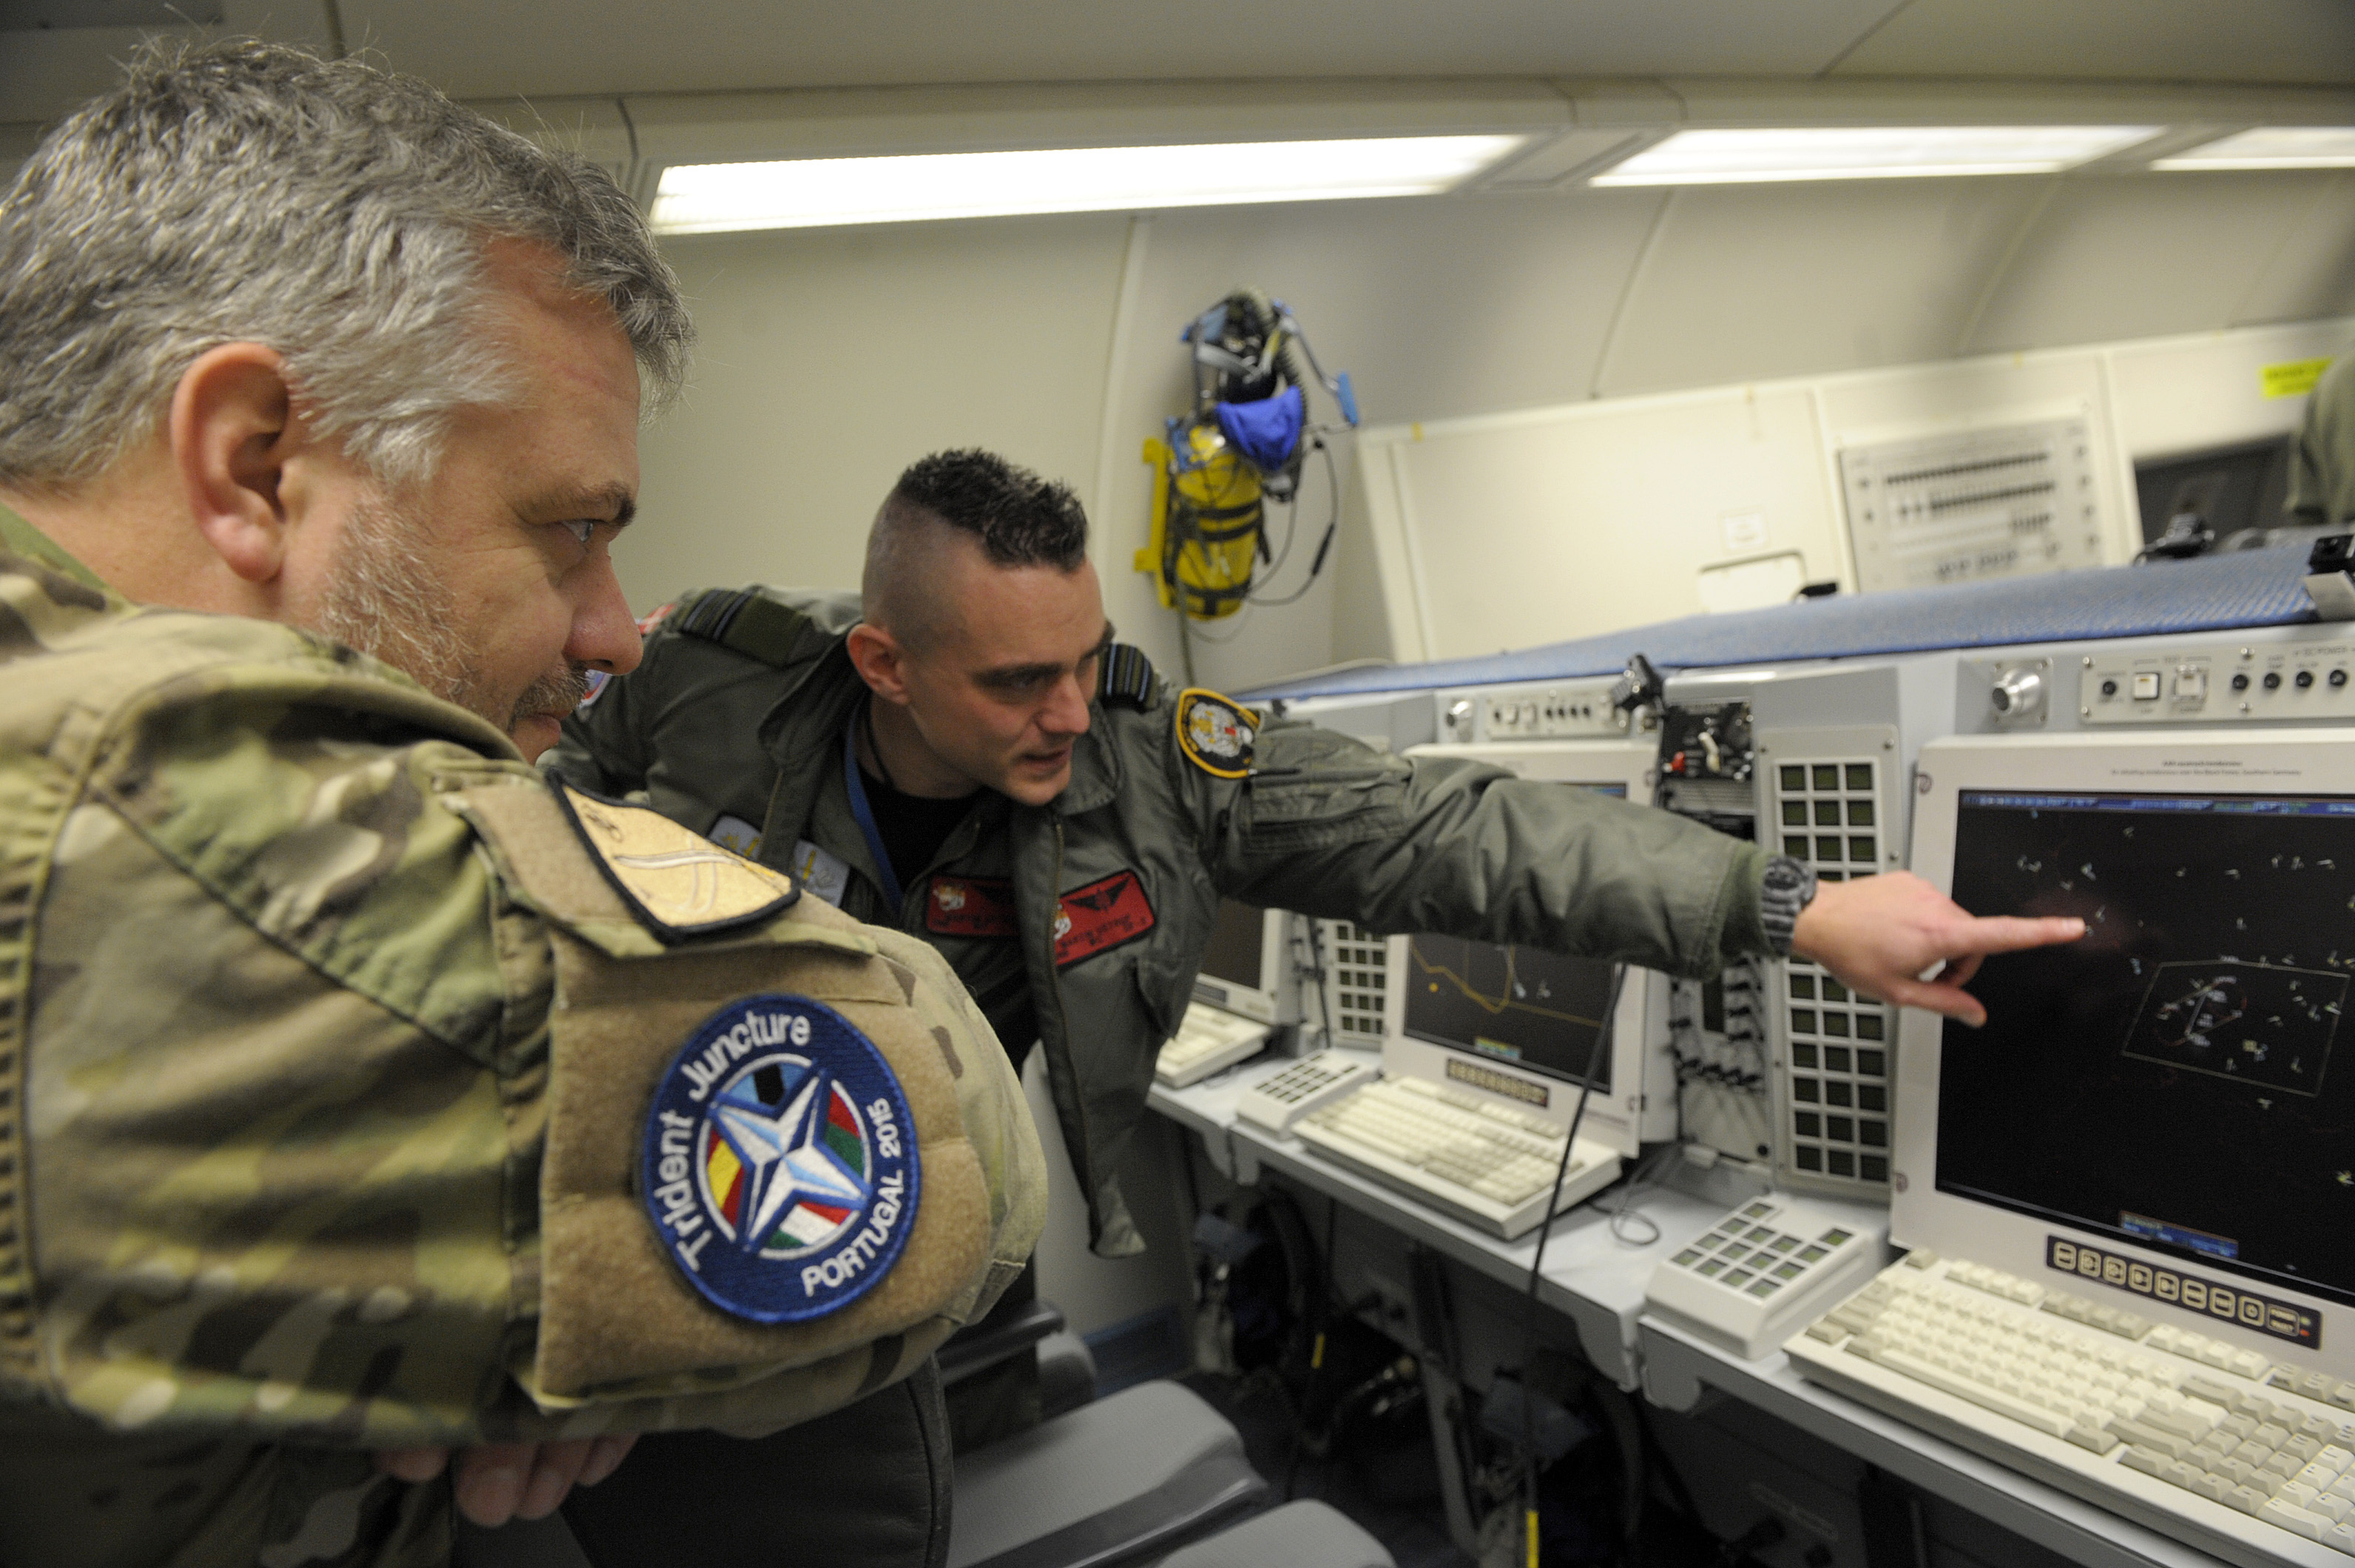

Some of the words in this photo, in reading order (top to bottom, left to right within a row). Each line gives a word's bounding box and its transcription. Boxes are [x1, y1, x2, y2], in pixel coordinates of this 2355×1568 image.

[681, 1010, 811, 1102] Juncture
[654, 1109, 712, 1271] Trident
[801, 1169, 905, 1297] PORTUGAL
[867, 1098, 902, 1158] 2015
